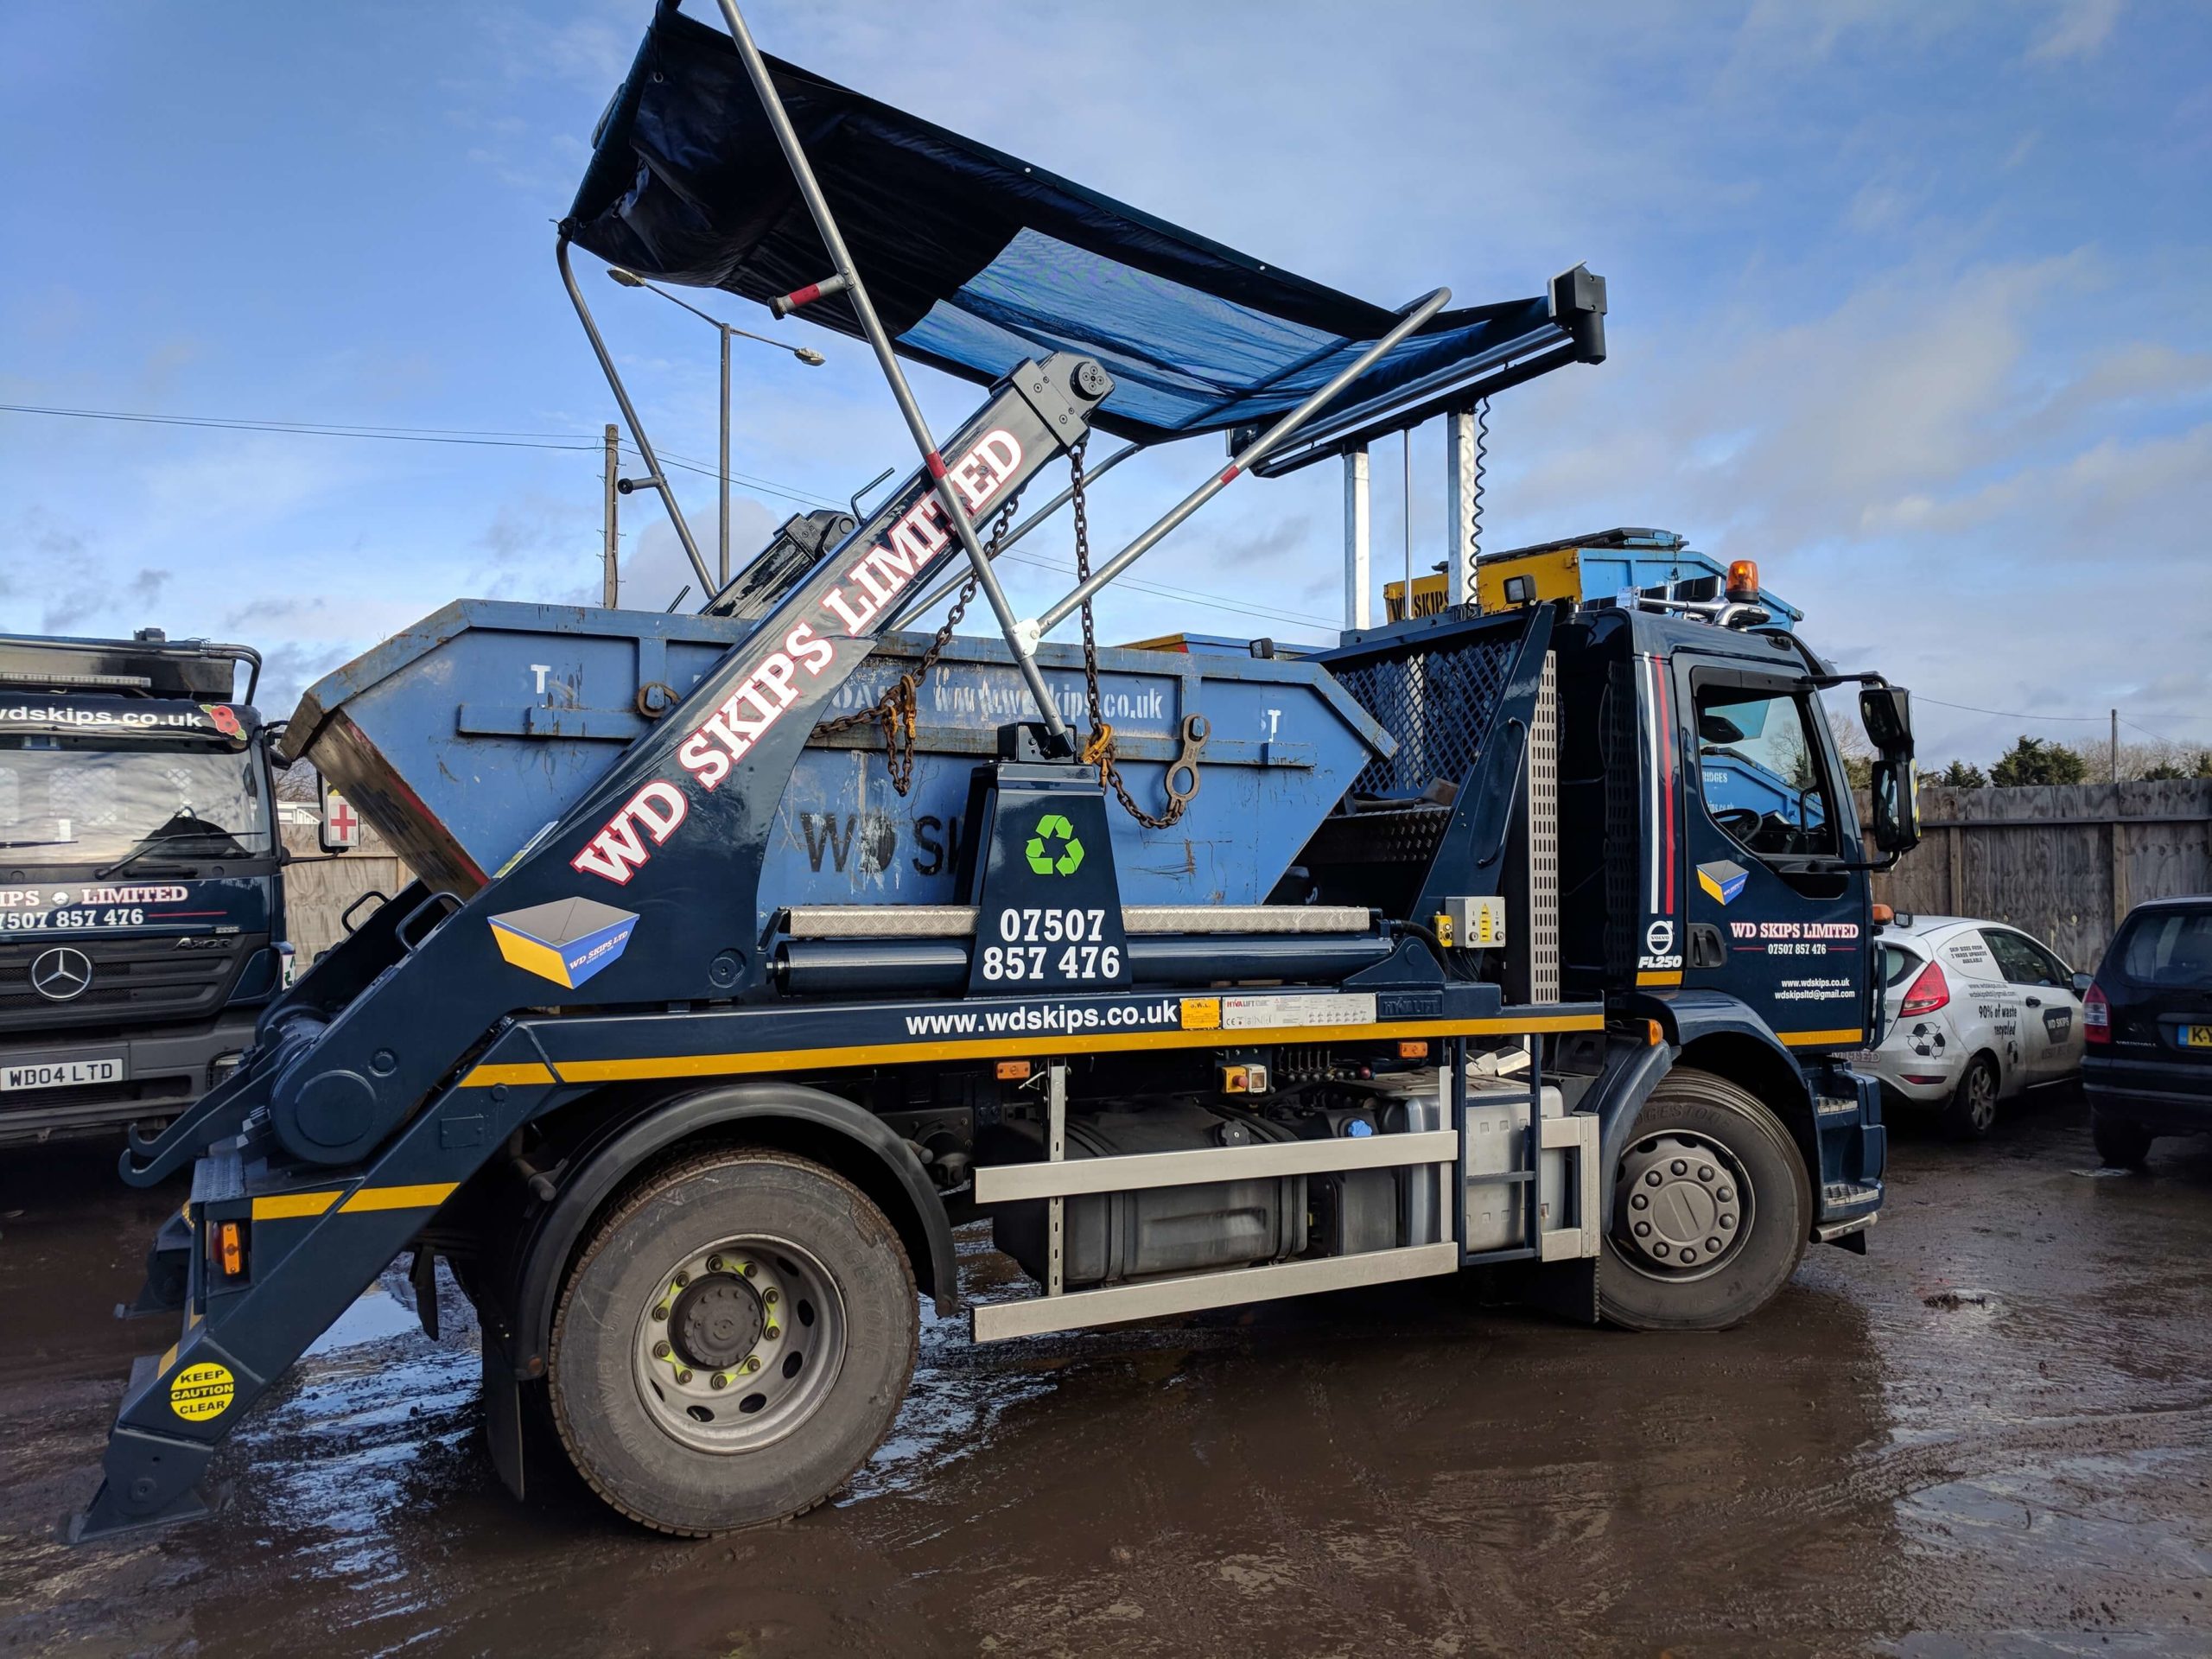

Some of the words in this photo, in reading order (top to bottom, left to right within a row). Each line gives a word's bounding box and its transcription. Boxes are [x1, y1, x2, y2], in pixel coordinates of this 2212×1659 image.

[569, 780, 689, 885] WD
[677, 619, 837, 791] SKIPS
[81, 886, 188, 906] LIMITED
[56, 911, 96, 927] 857
[104, 908, 144, 925] 476
[1000, 908, 1105, 942] 07507
[1731, 922, 1757, 938] WD
[1760, 922, 1801, 938] SKIPS
[1802, 923, 1859, 939] LIMITED
[569, 955, 587, 969] WD
[588, 939, 613, 959] SKIPS
[613, 931, 628, 944] LTD
[1768, 944, 1793, 955] 07507
[1795, 944, 1810, 955] 857
[1812, 944, 1827, 955] 476
[982, 946, 1047, 981] 857
[1058, 945, 1120, 979] 476
[1637, 955, 1682, 969] FL250
[1781, 977, 1850, 988] www.wdskips.co.uk
[1774, 988, 1855, 1001] wdskipsltd@gmail.com
[906, 1000, 1178, 1035] www.wdskips.co.uk
[1979, 1005, 1993, 1018] 90%
[1994, 1002, 2001, 1018] of
[2002, 1005, 2017, 1018] waste
[1994, 1020, 2017, 1039] recycled
[73, 1063, 112, 1082] LTD
[180, 1370, 225, 1384] KEEP
[171, 1383, 234, 1401] CAUTION
[180, 1401, 226, 1414] CLEAR
